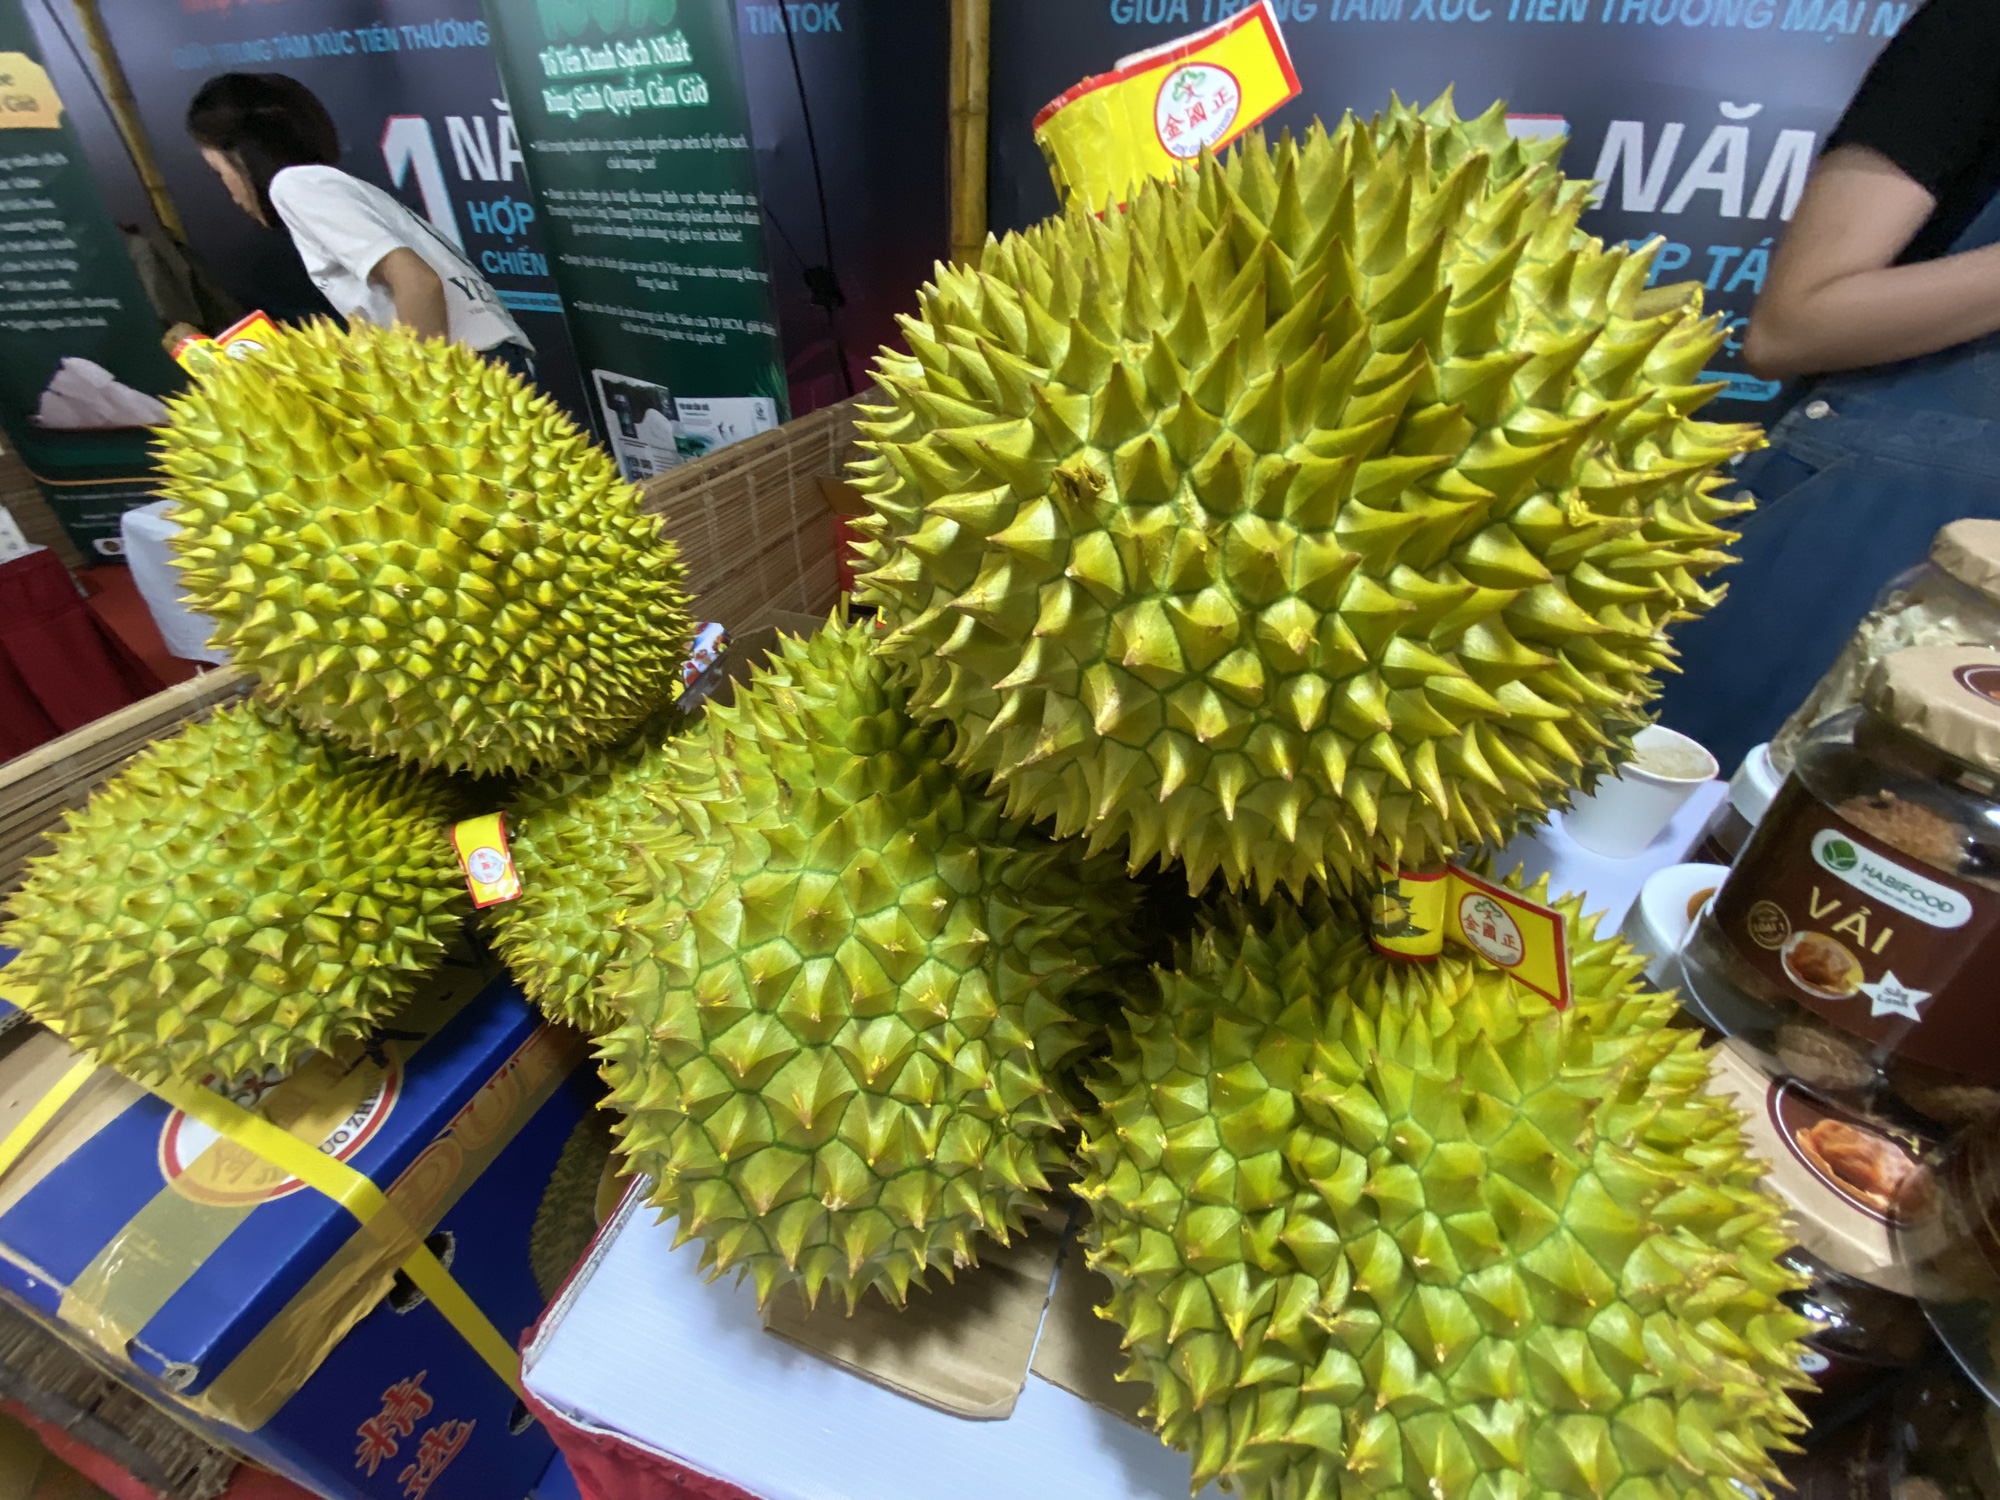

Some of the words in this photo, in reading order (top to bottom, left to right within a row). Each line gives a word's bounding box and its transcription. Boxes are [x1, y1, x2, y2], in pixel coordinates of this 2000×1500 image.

[745, 2, 843, 34] TIKTOK
[1203, 0, 1318, 23] TRNG
[647, 73, 679, 106] Cần
[678, 75, 710, 104] Giờ
[444, 98, 525, 182] NĂ
[467, 195, 536, 243] HỢP
[482, 245, 550, 277] CHIẾN
[1705, 237, 1775, 295] TÁ
[1861, 862, 1955, 914] HABIFOOD
[1808, 886, 1895, 954] VẢI
[318, 1130, 350, 1155] UO
